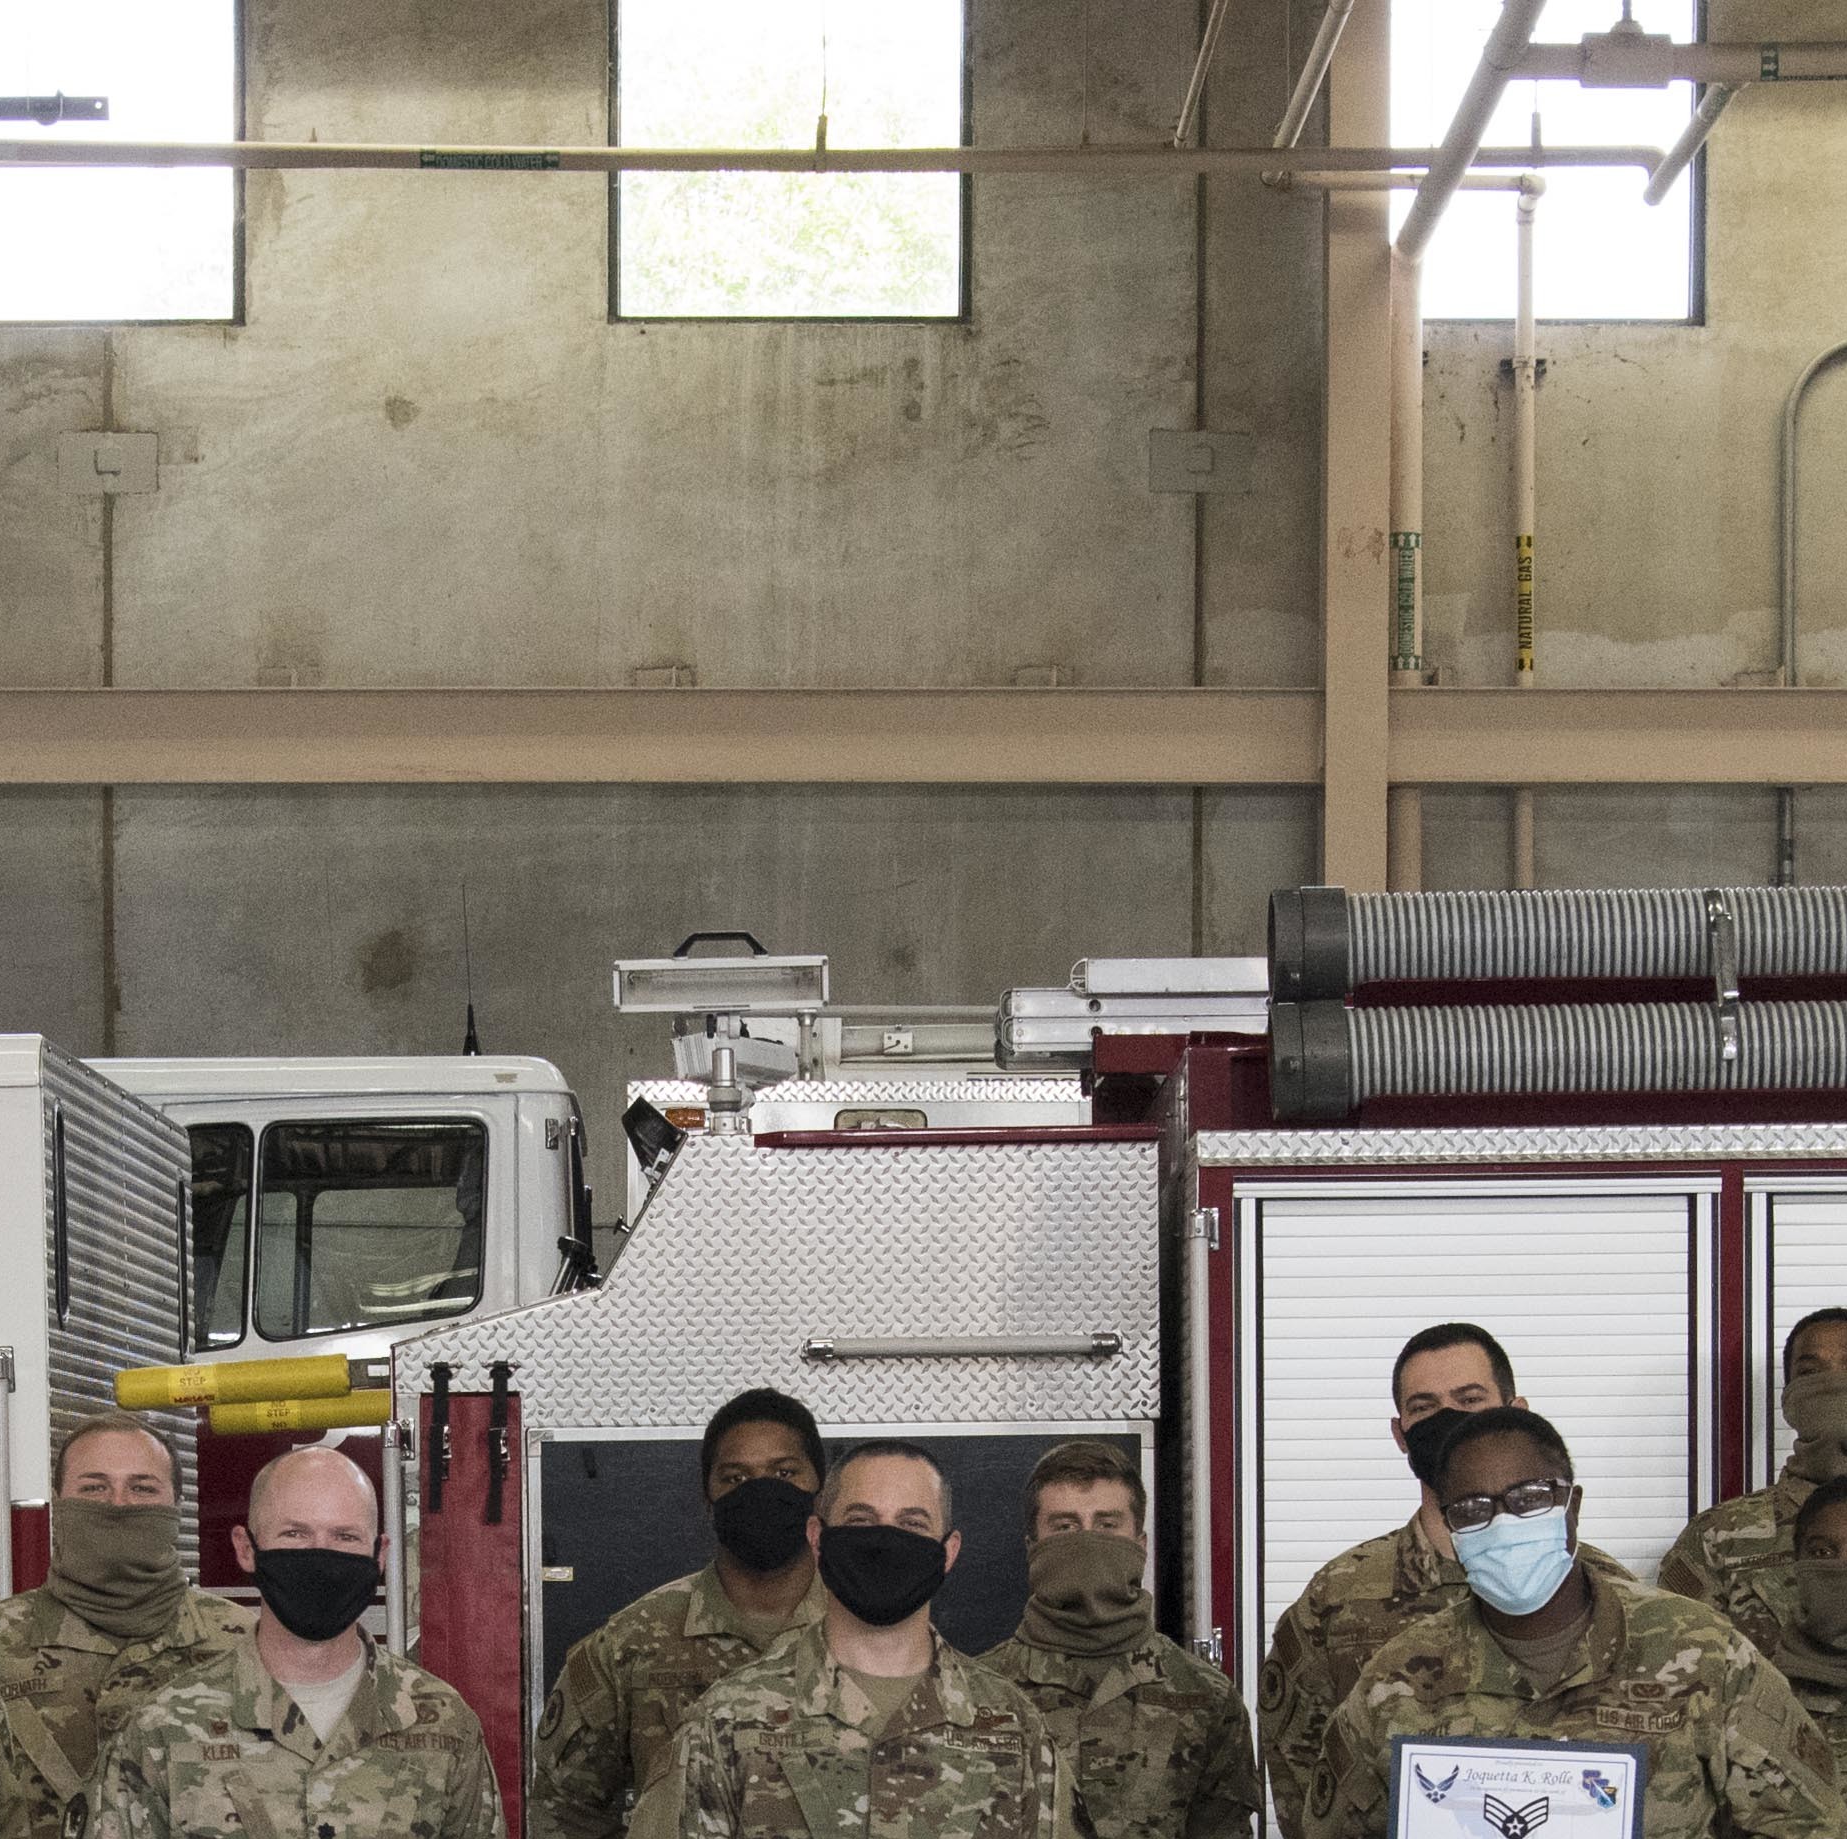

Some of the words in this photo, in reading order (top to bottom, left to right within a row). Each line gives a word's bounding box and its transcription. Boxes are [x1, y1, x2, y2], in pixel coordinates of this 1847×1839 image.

[1399, 549, 1414, 578] WATER
[1517, 556, 1532, 582] GAS
[1399, 582, 1414, 605] COLD
[1517, 590, 1533, 650] NATURAL
[1399, 609, 1414, 654] DOMESTIC
[179, 1377, 207, 1388] STEP
[266, 1408, 291, 1418] STEP
[0, 1678, 48, 1698] ORVATH
[1624, 1712, 1646, 1729] AIR
[404, 1733, 426, 1749] AIR
[202, 1744, 241, 1761] KLEIN
[1462, 1769, 1519, 1785] Joquetta
[1540, 1770, 1574, 1785] Rolle
